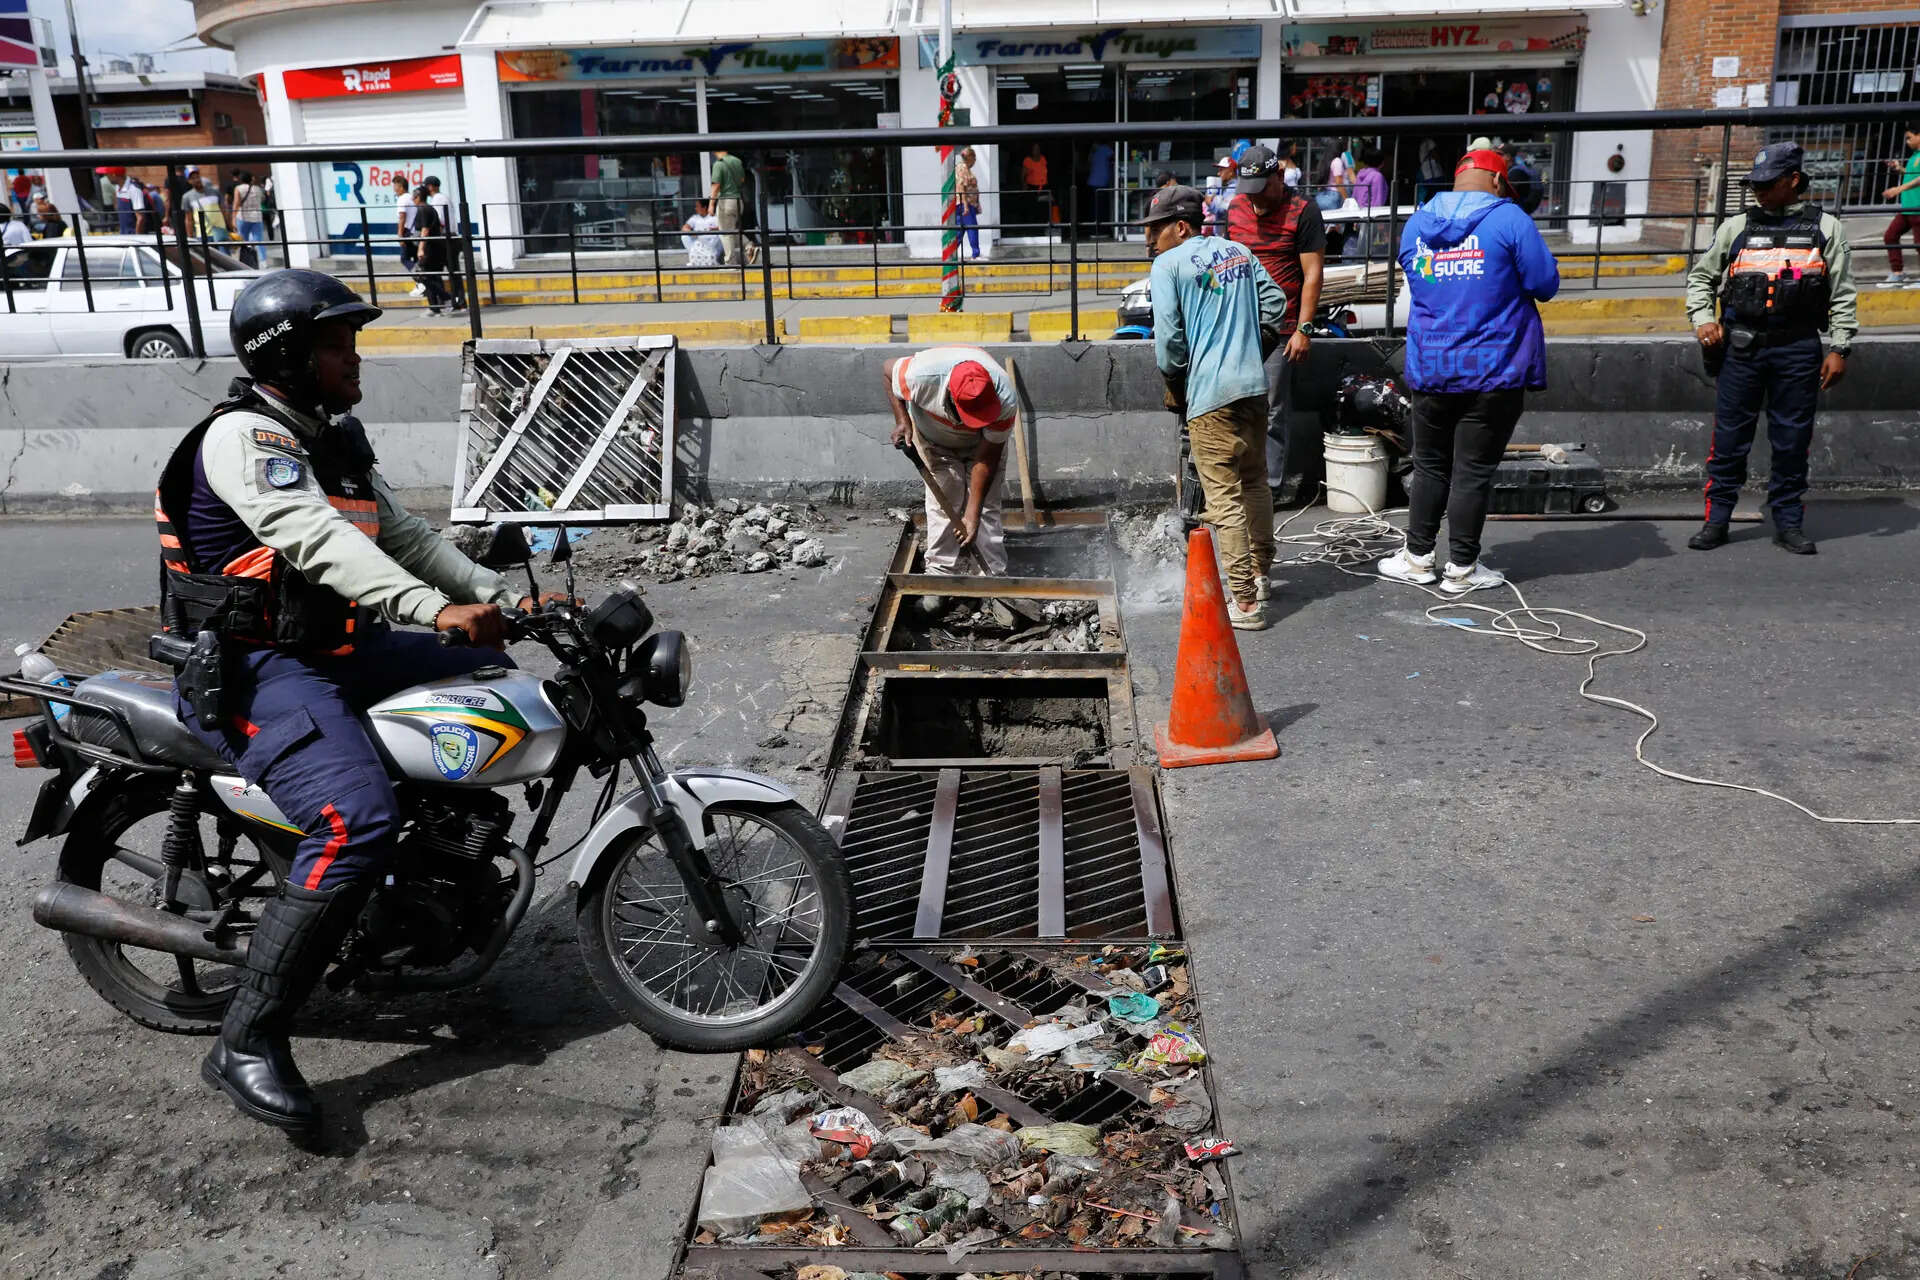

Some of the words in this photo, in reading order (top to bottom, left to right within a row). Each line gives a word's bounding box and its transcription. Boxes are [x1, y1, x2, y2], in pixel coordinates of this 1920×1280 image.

[1431, 25, 1480, 46] HYZ
[976, 38, 1083, 58] Farma
[1113, 34, 1197, 58] Tuya
[577, 55, 694, 74] Farma
[362, 68, 391, 84] Rapid
[1212, 246, 1241, 265] PLAN
[1434, 260, 1484, 277] SUCRE
[243, 319, 293, 354] POLISUCRE
[425, 695, 487, 707] POLISUCRE
[460, 745, 476, 773] SUCRE
